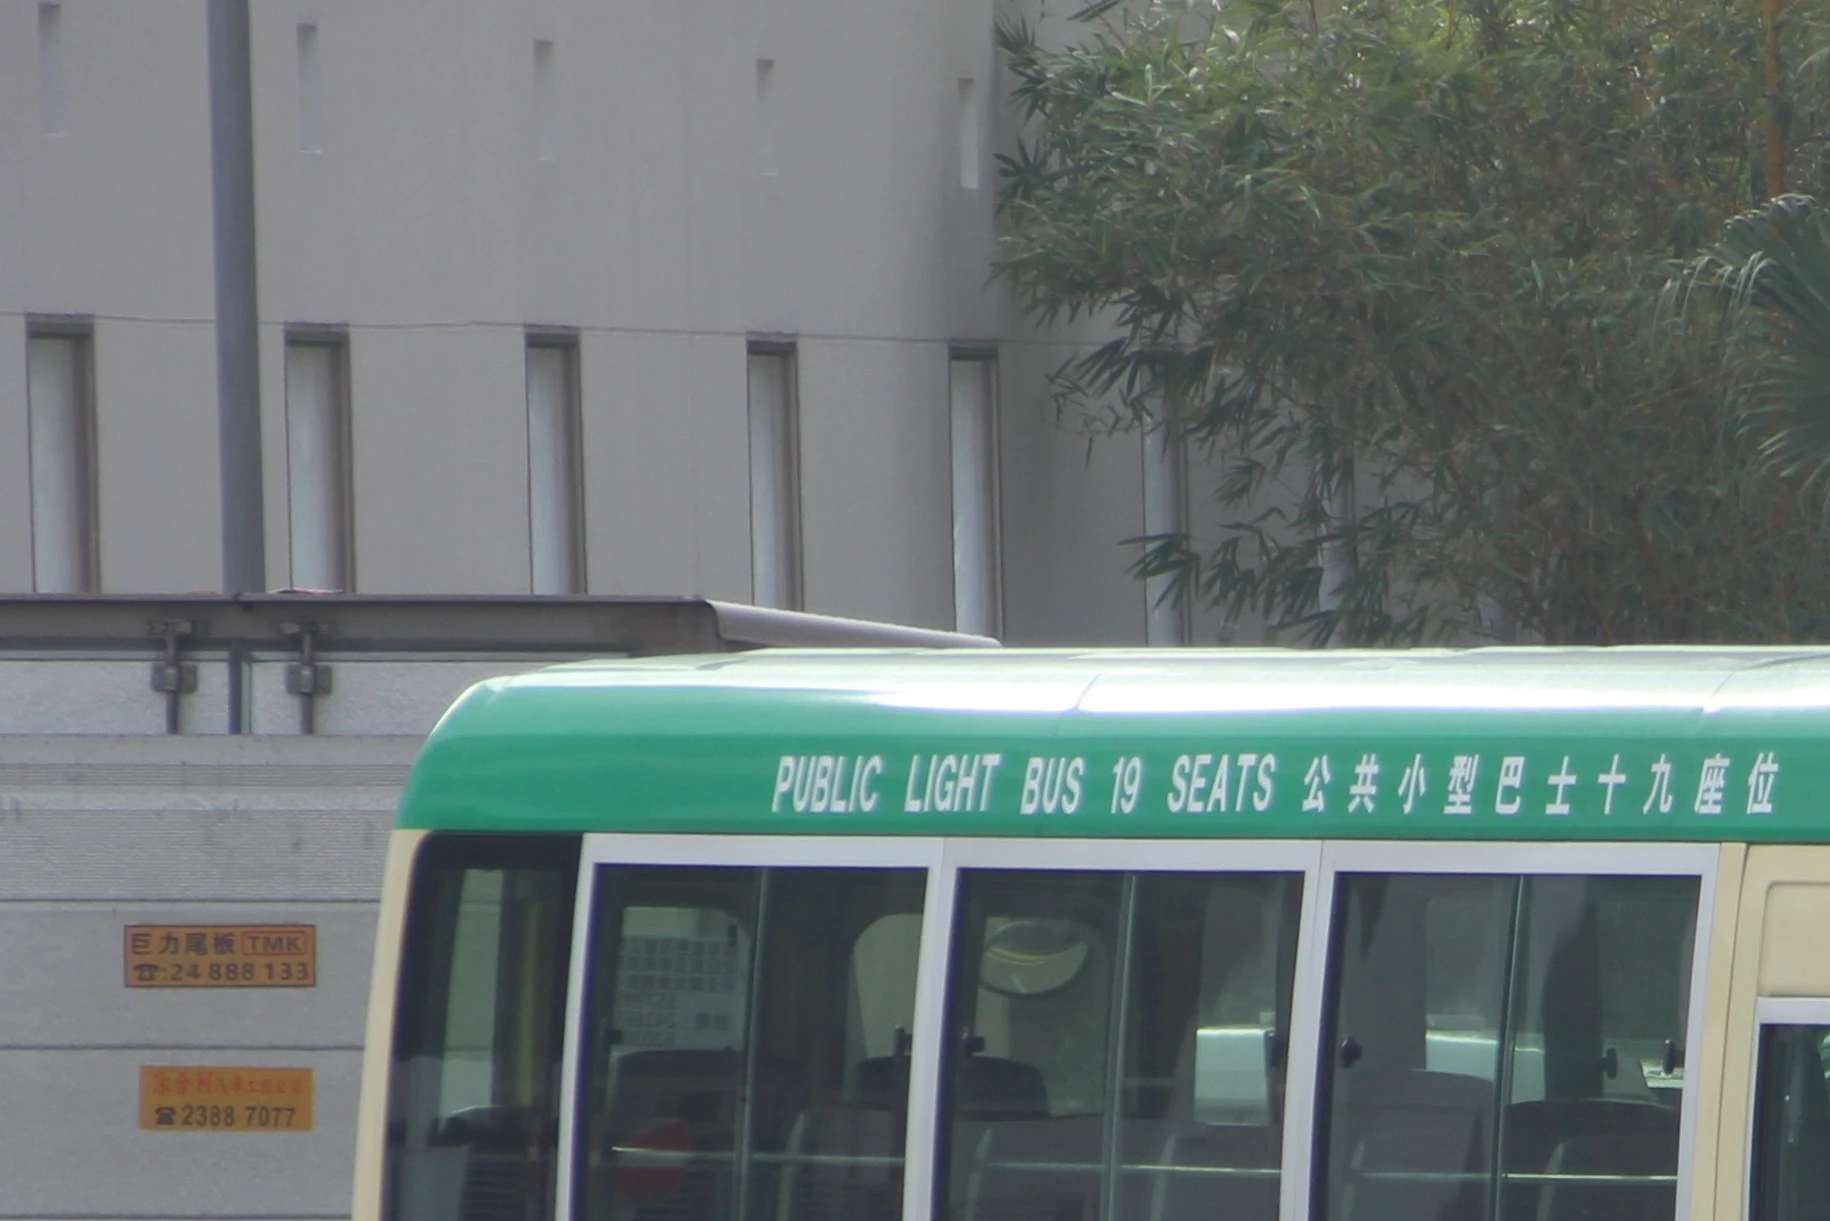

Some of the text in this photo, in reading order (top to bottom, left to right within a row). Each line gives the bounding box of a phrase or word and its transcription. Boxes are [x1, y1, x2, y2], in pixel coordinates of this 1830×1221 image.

[771, 753, 1277, 815] PUBLIC LIGHT BUS 19 SEATS
[1301, 751, 1780, 816] 公共小型巴士十九座位
[246, 935, 301, 952] TMK
[208, 963, 255, 981] 888
[264, 962, 309, 981] 133
[180, 1104, 297, 1128] 2388 7077
